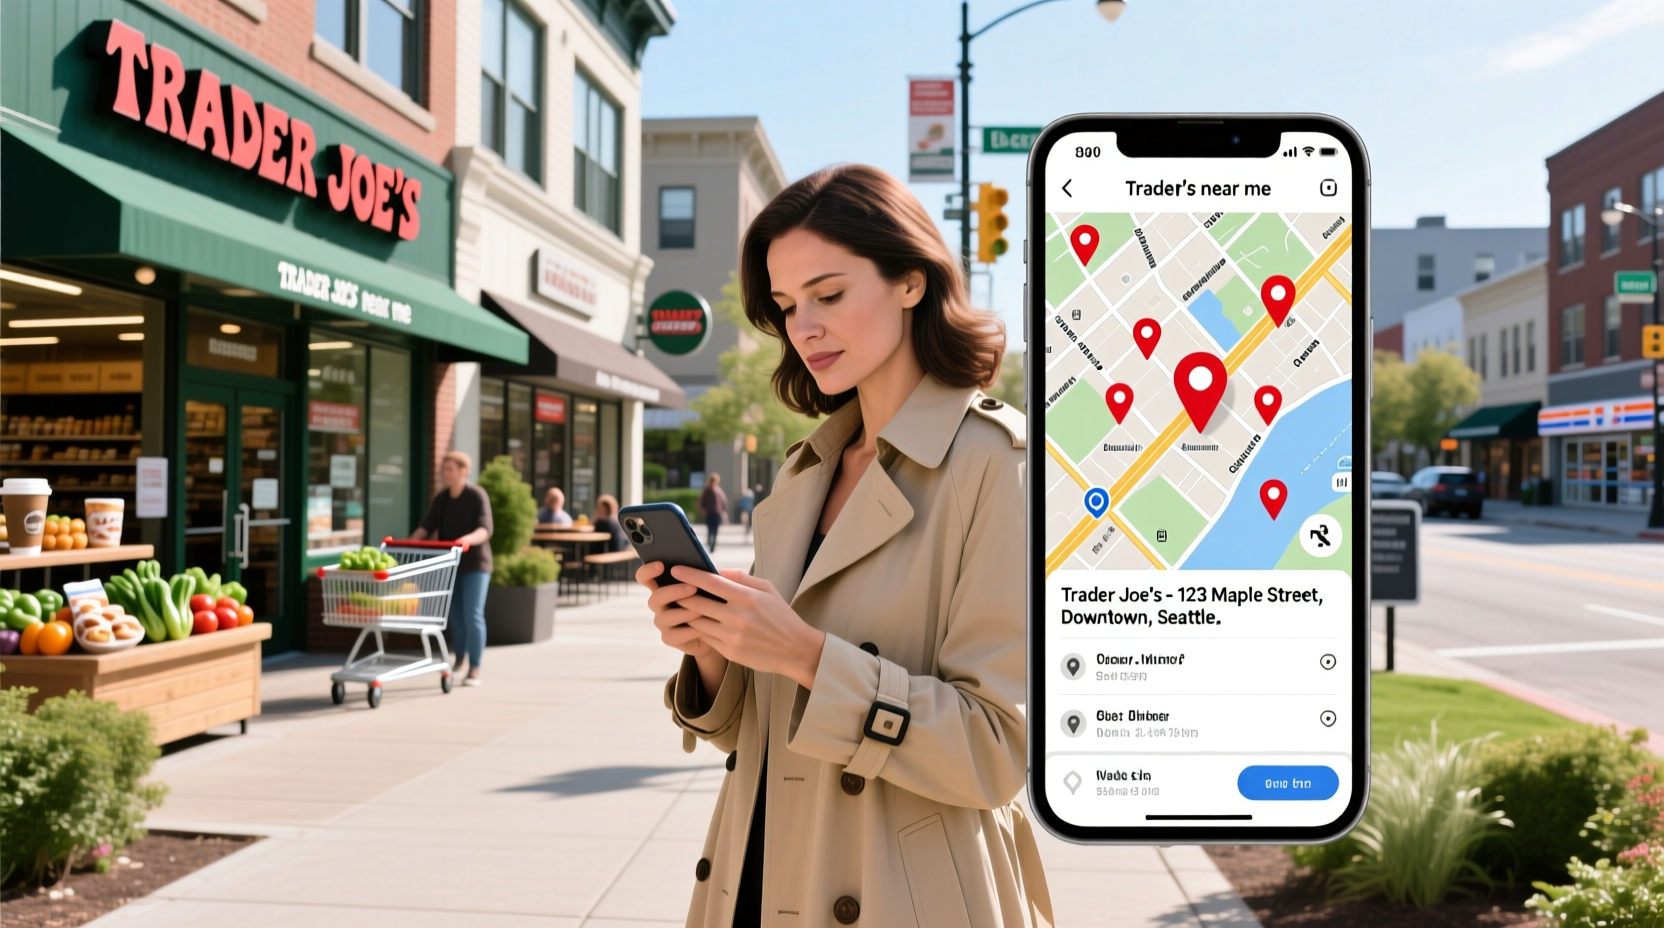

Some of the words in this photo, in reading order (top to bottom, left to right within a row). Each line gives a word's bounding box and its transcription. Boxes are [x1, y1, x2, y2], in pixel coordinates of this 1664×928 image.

[106, 18, 317, 198] TRADER
[327, 143, 422, 241] JOE'S
[1125, 179, 1196, 197] Trader's
[1201, 183, 1240, 197] near
[1244, 183, 1272, 197] me
[277, 261, 330, 302] TRADER
[1060, 586, 1116, 603] Trader
[1118, 586, 1163, 603] Joe's
[1177, 586, 1207, 603] 123
[1211, 586, 1263, 607] Maple
[1267, 586, 1323, 607] Street,
[1061, 609, 1153, 628] Downtown,
[1157, 608, 1222, 626] Seattle.
